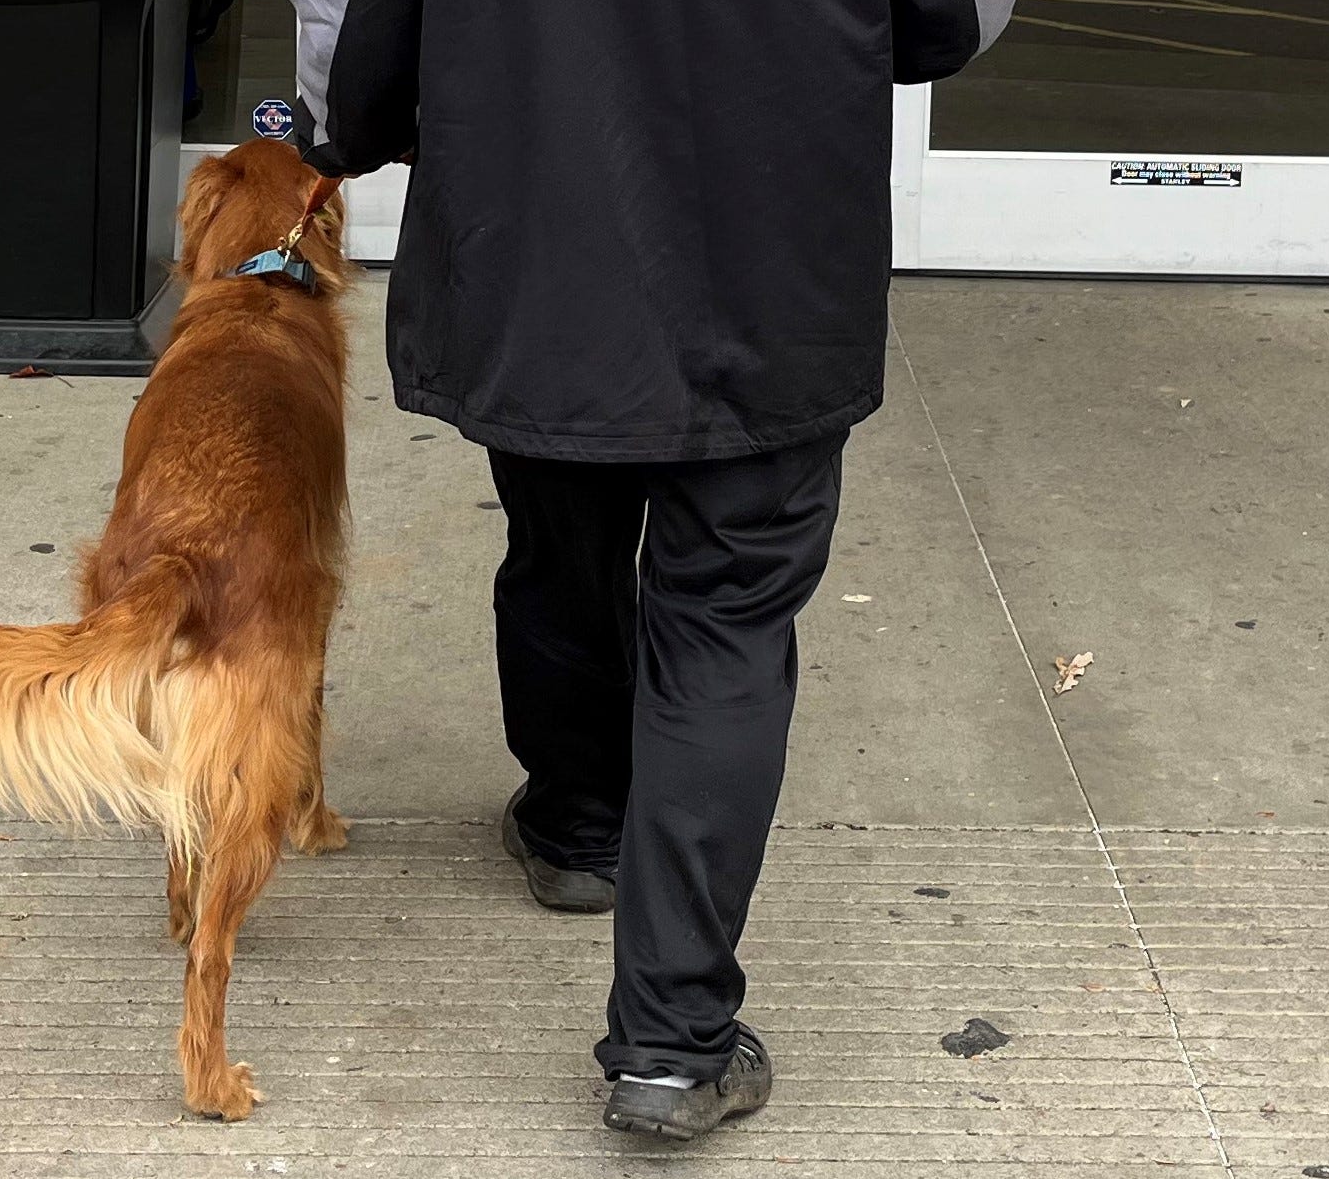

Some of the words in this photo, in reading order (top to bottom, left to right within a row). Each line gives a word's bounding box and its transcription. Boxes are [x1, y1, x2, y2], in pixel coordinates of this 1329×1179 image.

[255, 115, 292, 123] VECTOR
[1146, 162, 1190, 171] AUTOMATIC
[1191, 163, 1220, 172] SLIDING
[1221, 163, 1242, 172] DOOR
[1122, 170, 1138, 178] Door
[1139, 171, 1153, 179] may
